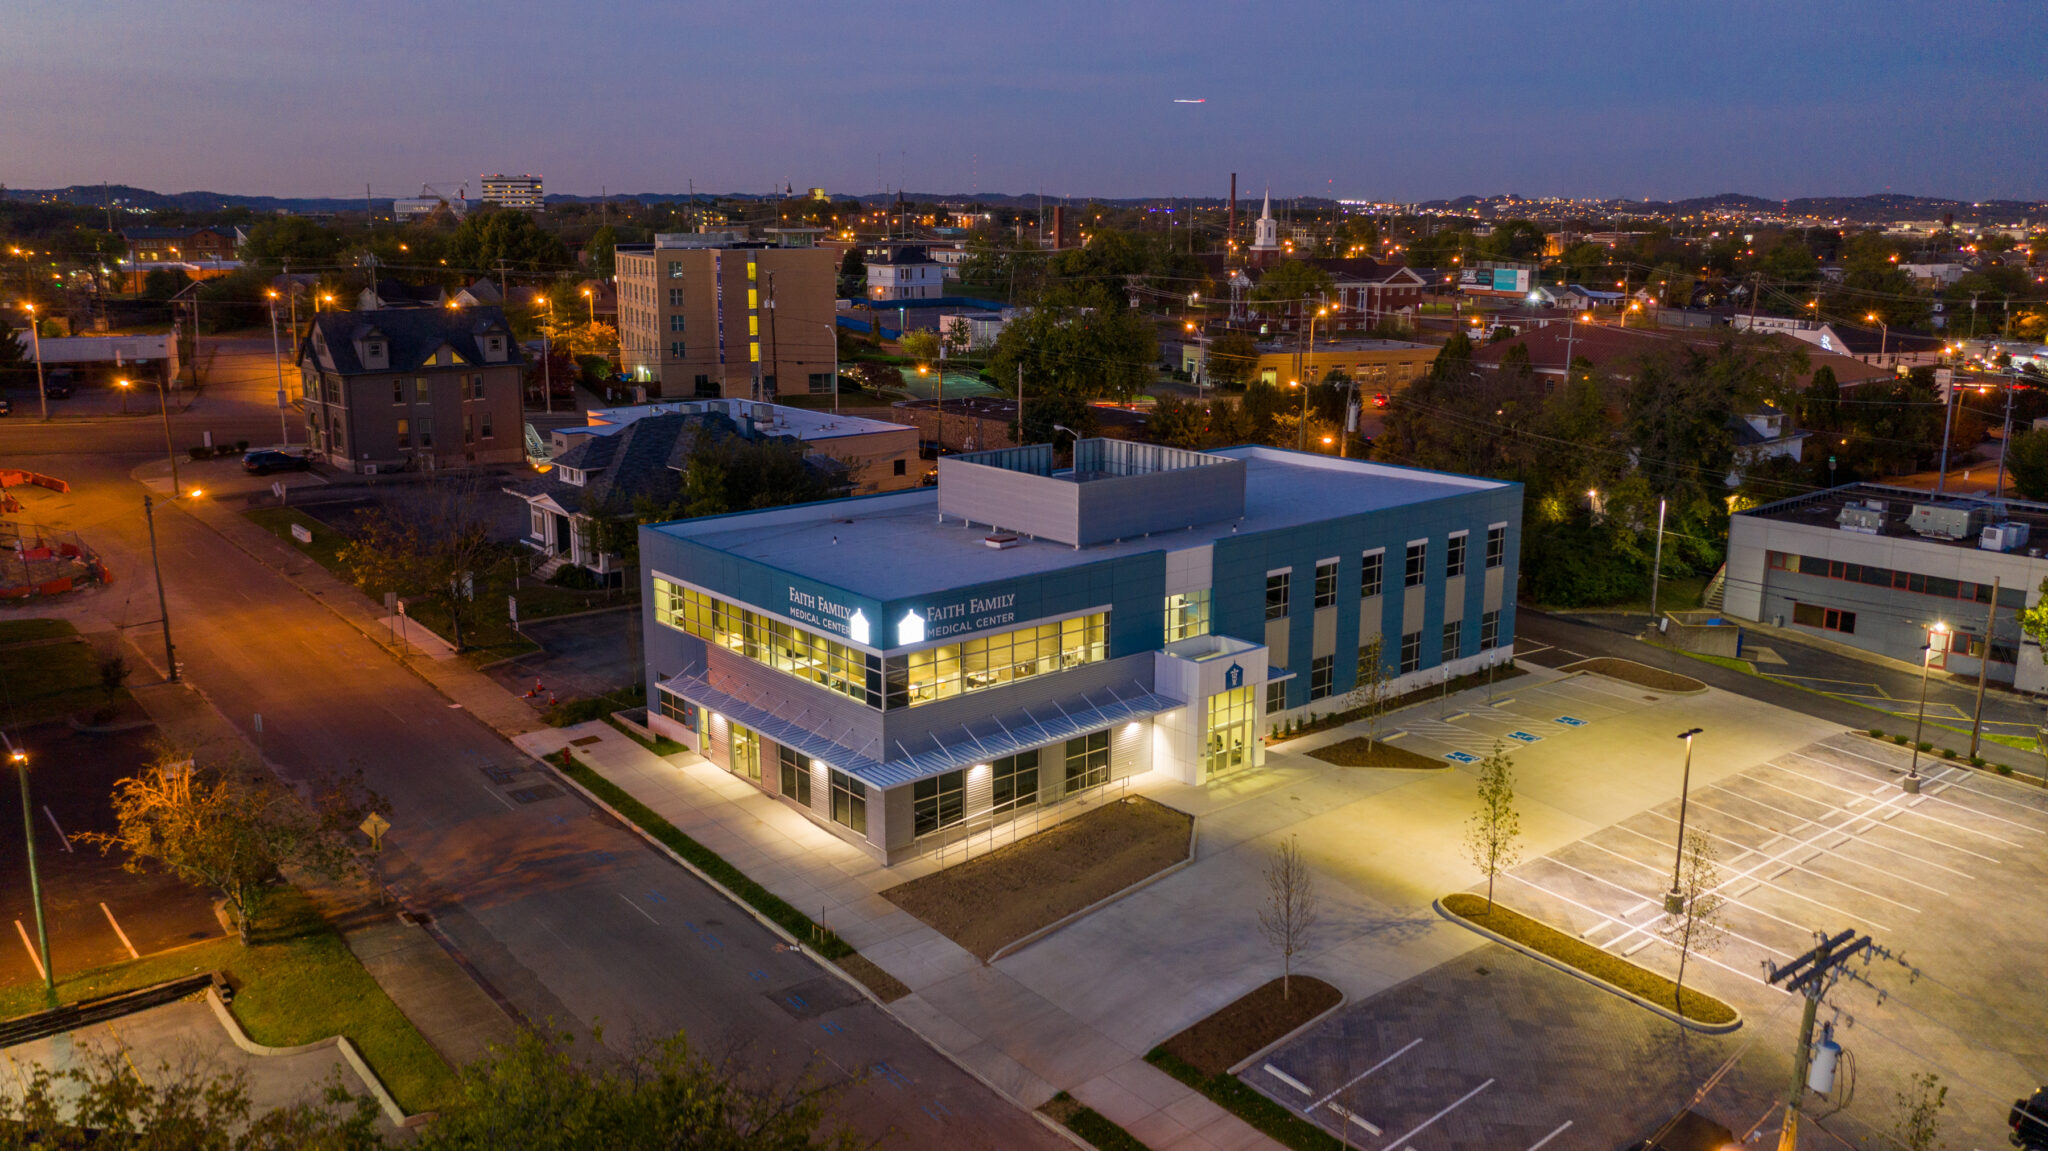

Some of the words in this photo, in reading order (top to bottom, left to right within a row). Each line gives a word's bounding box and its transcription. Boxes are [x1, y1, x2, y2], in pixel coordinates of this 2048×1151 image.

[789, 586, 815, 609] FAITH
[818, 595, 851, 620] FAMILY
[790, 606, 821, 626] MEDICAL
[927, 603, 965, 622] FAITH
[969, 593, 1015, 614] FAMILY
[927, 621, 973, 638] MEDICAL
[975, 612, 1015, 629] CENTER
